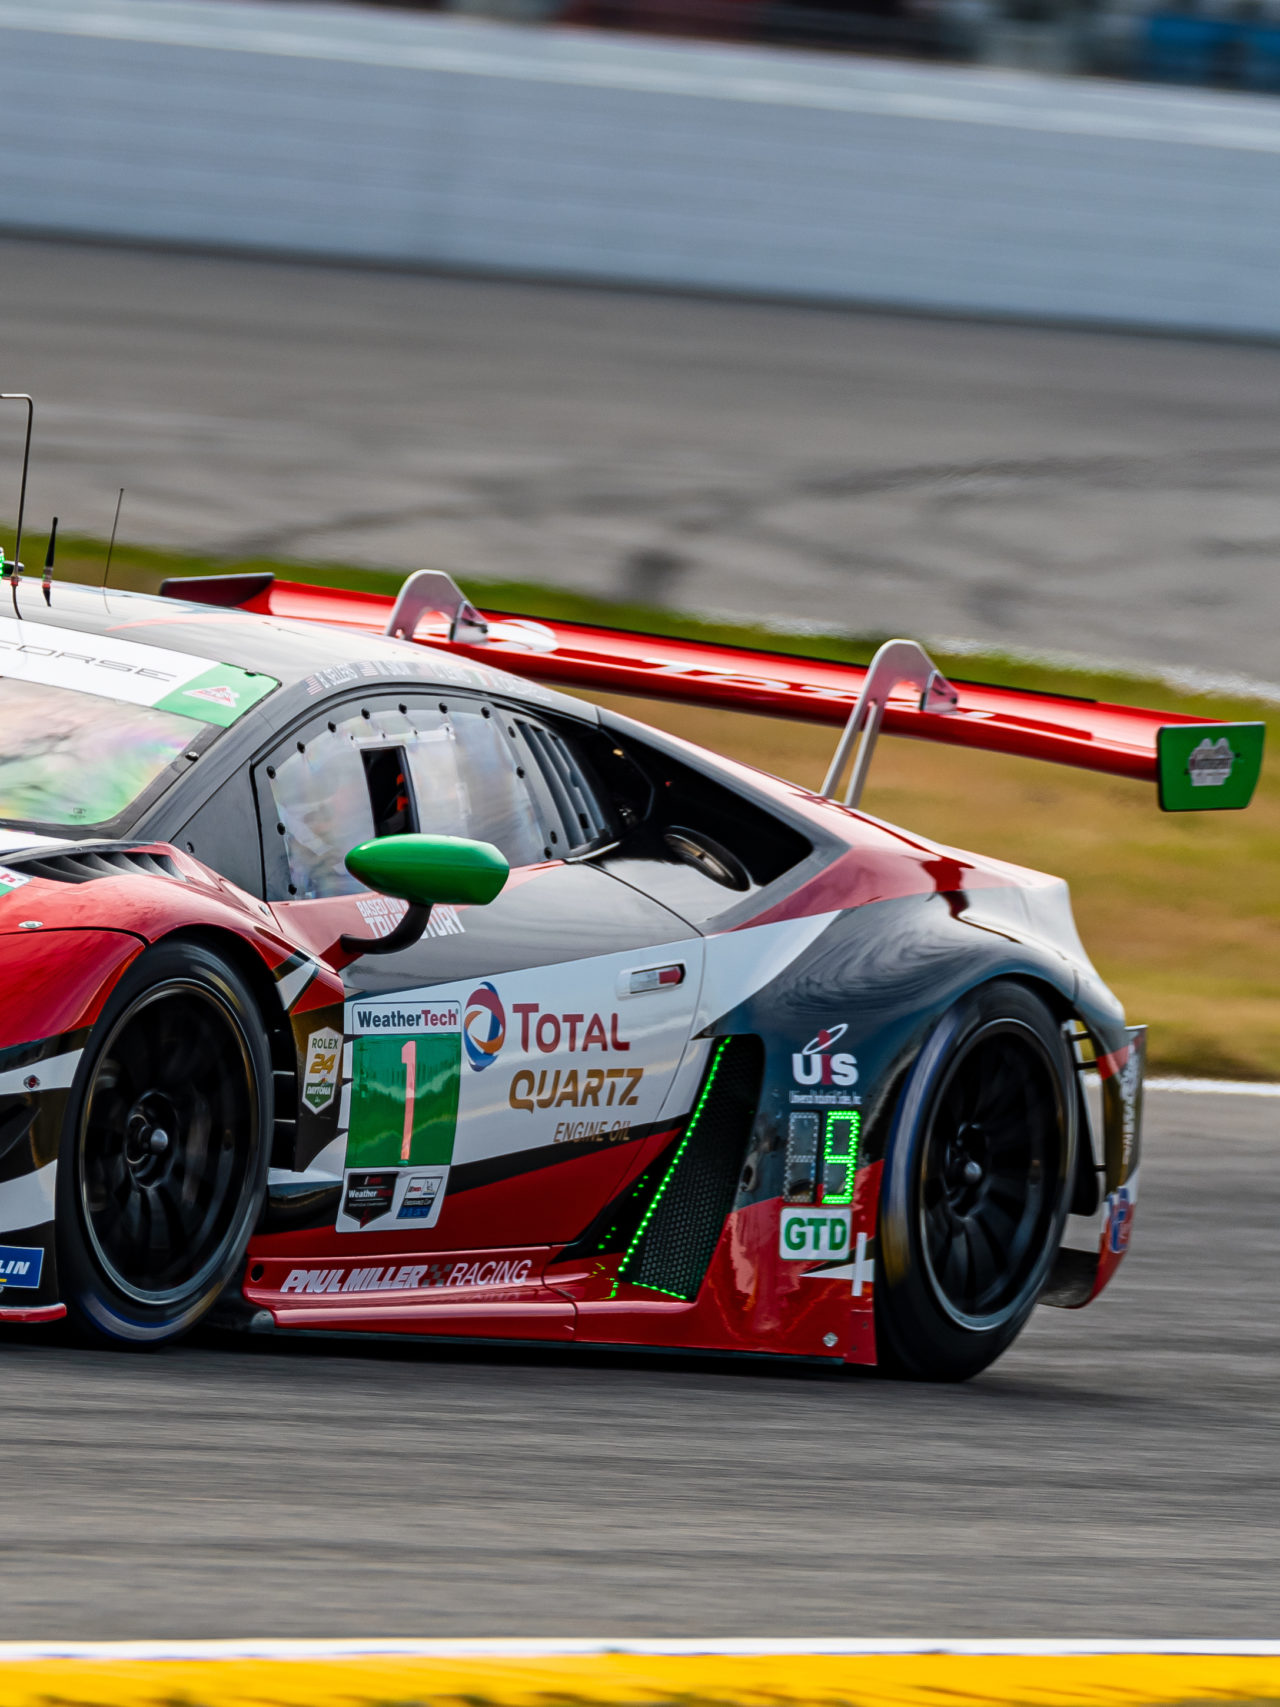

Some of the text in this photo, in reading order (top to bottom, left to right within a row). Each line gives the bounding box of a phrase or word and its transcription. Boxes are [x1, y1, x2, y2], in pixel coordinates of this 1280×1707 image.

[356, 898, 389, 917] BASED
[384, 896, 401, 913] ON
[357, 1008, 458, 1028] WeatherTech
[512, 1003, 631, 1053] TOTAL
[312, 1038, 338, 1049] ROLEX
[309, 1053, 336, 1075] 24
[400, 1040, 417, 1160] 1
[509, 1067, 644, 1114] QUARTZ
[553, 1119, 632, 1143] ENGINE OIL
[821, 1110, 861, 1204] 9
[784, 1217, 847, 1251] GTD
[279, 1260, 533, 1293] PAUL MILLER RACING
